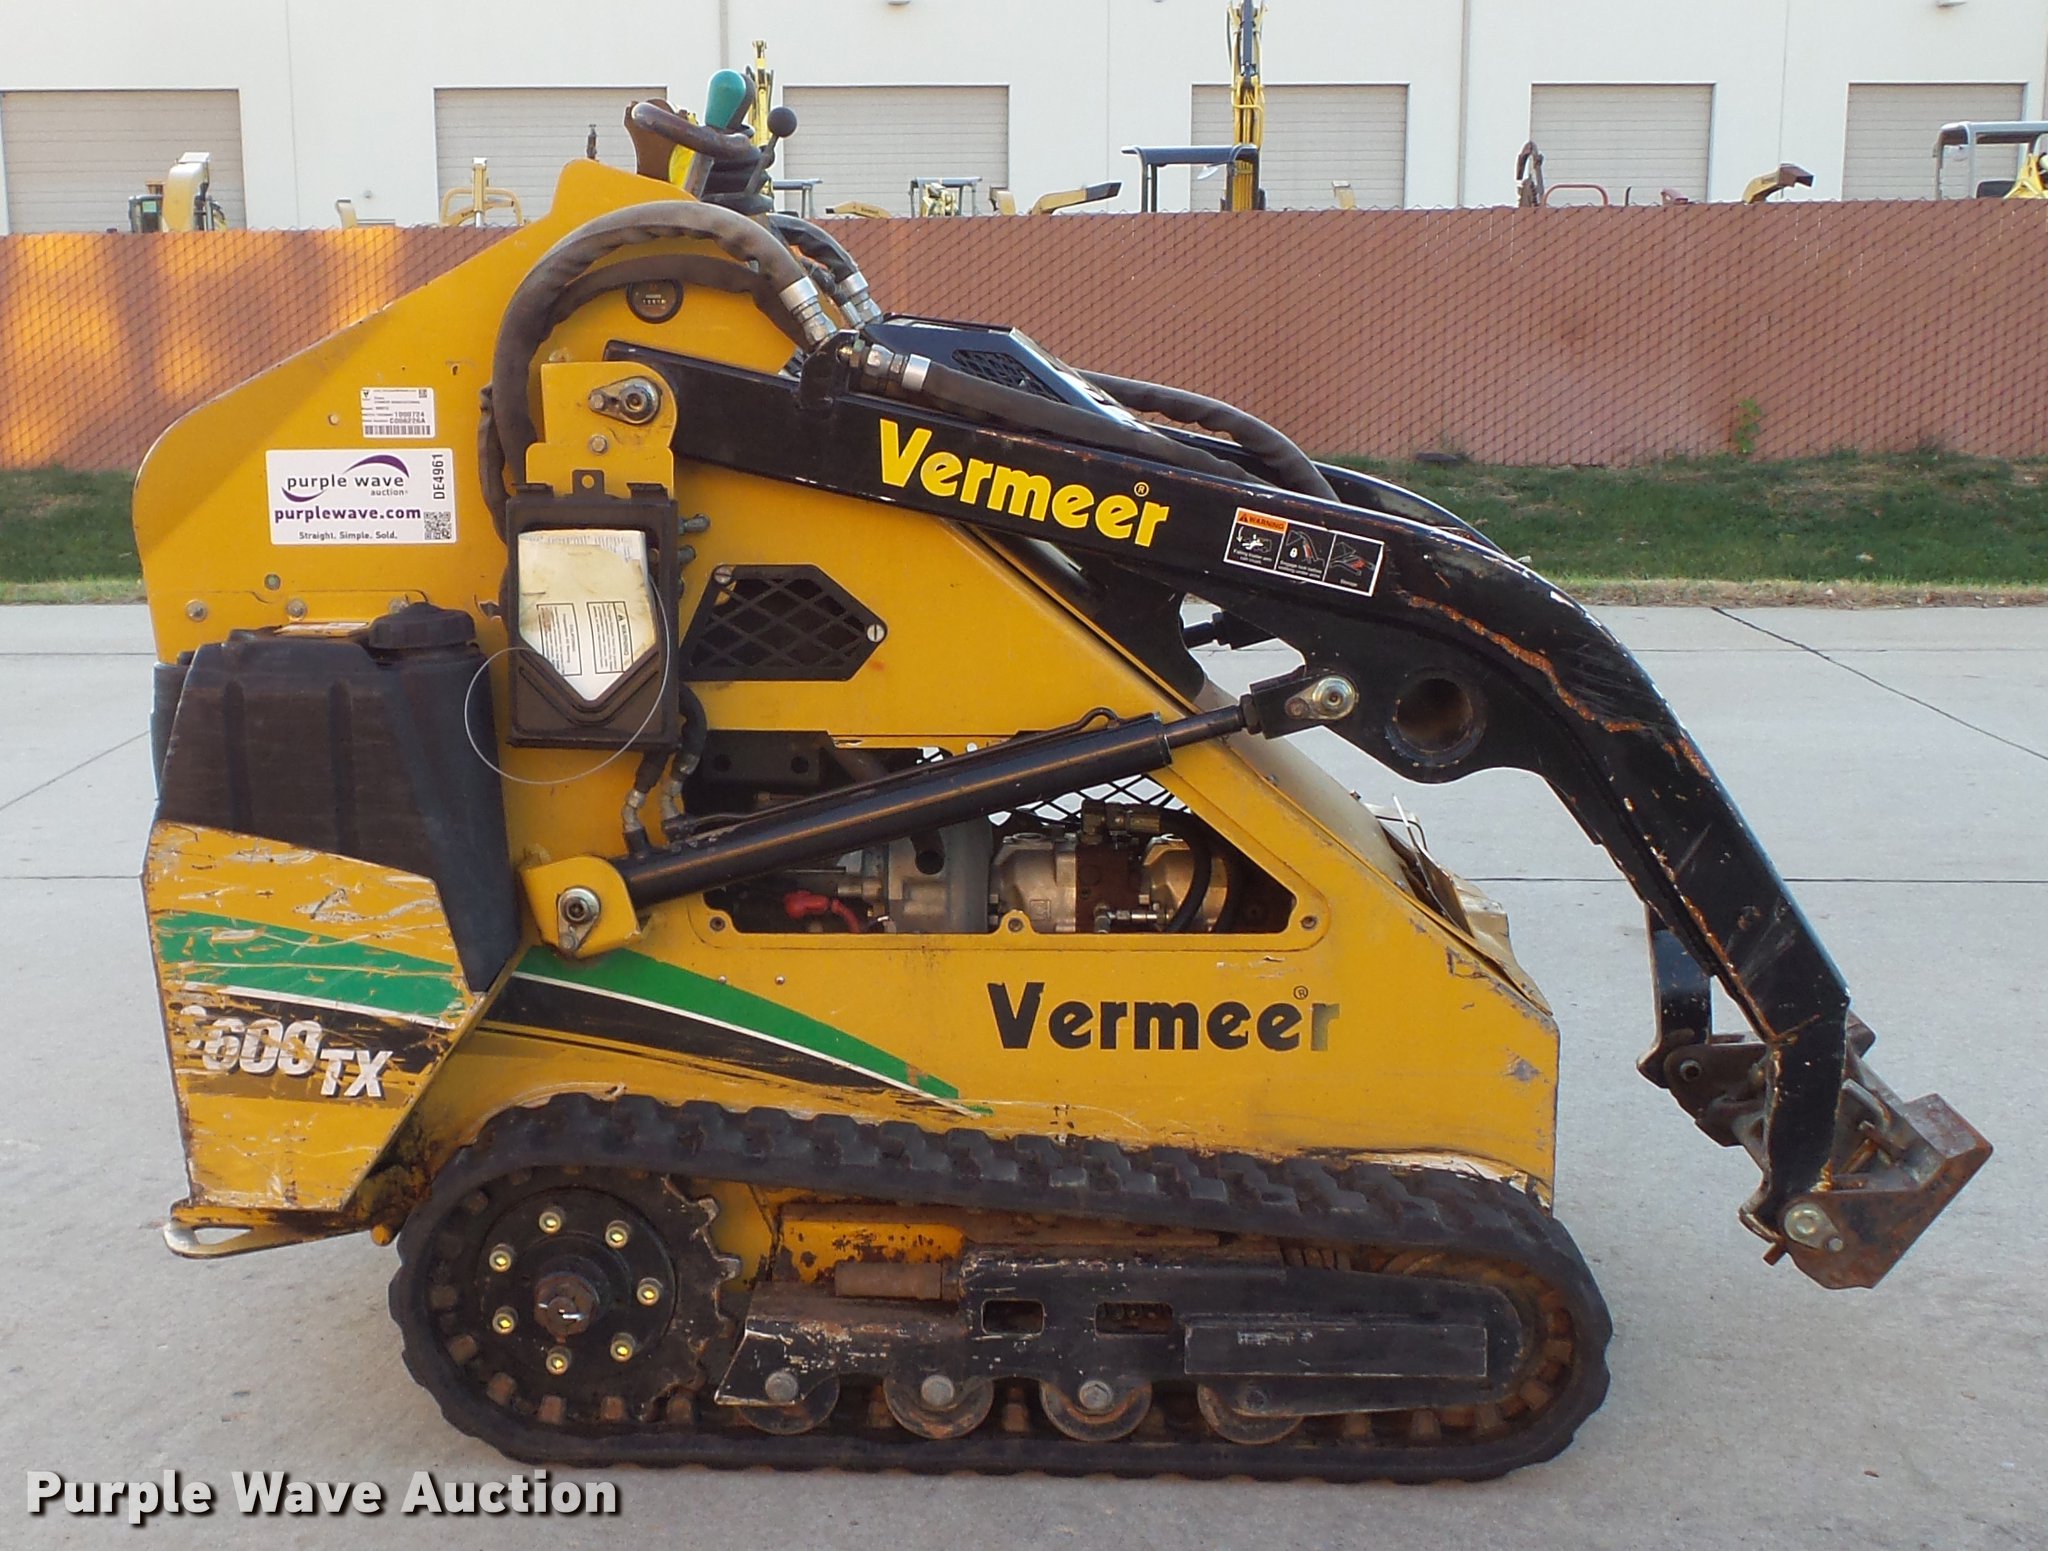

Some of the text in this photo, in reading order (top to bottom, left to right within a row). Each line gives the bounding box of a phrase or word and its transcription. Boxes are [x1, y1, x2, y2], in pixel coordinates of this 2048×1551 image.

[287, 474, 404, 490] purple wave
[432, 453, 446, 500] DE4961
[880, 418, 1169, 547] Vermeer
[370, 488, 404, 497] auction
[274, 506, 421, 523] purplewave.com
[1249, 515, 1284, 530] WARNING
[299, 531, 398, 541] Straight. Simple. Sold.
[986, 981, 1340, 1051] Vermeer
